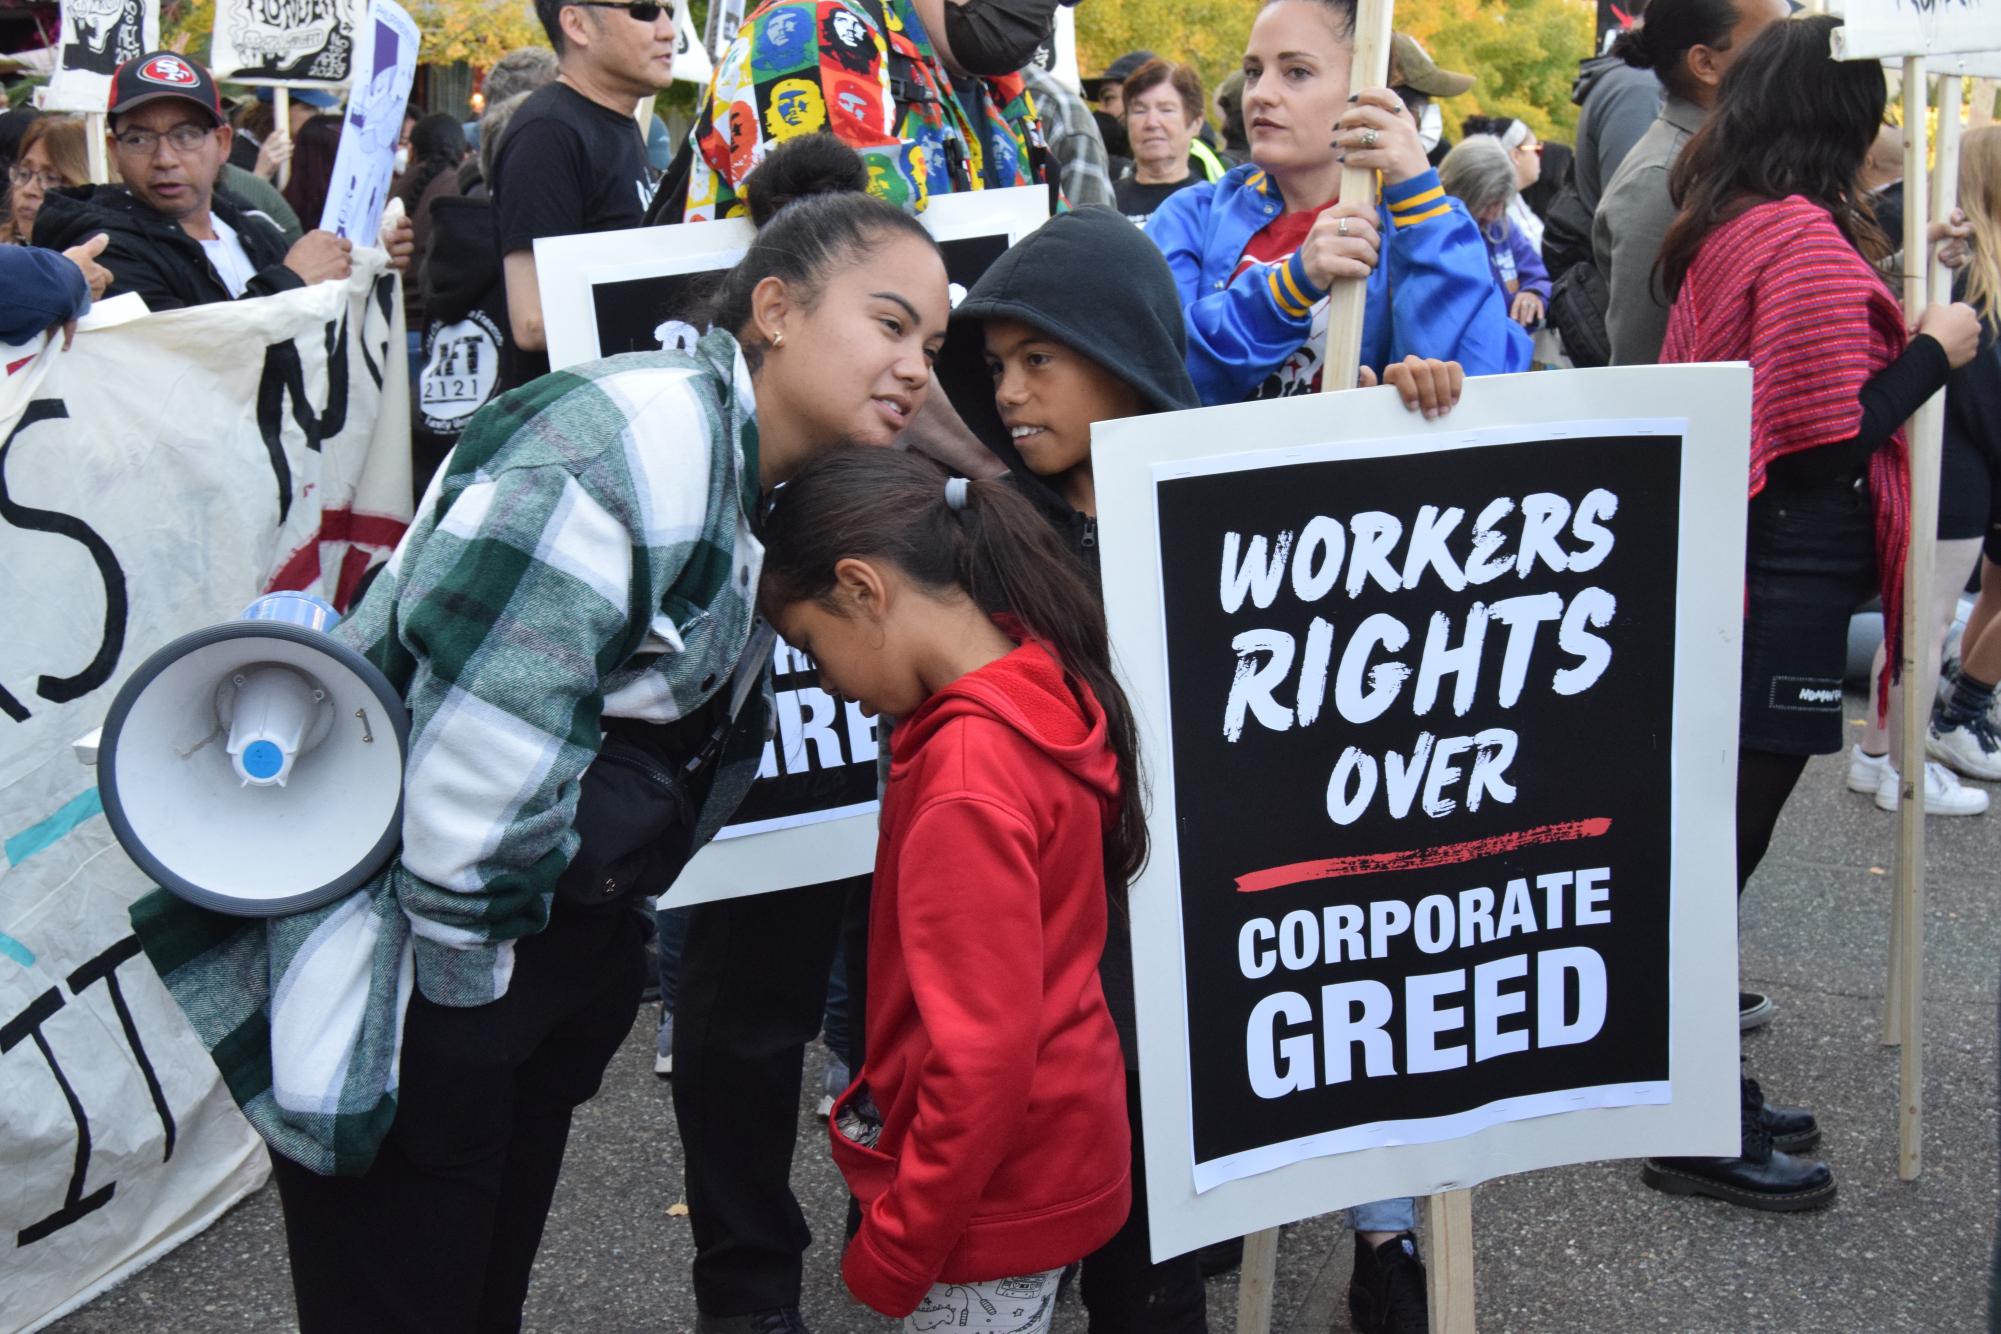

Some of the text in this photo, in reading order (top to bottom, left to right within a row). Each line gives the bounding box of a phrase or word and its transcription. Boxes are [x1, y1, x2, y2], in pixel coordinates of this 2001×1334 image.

[423, 378, 478, 399] 2121
[1219, 487, 1619, 614] WORKERS
[1222, 586, 1617, 744] RIGHTS
[1325, 727, 1518, 827] OVER
[1237, 865, 1612, 980] CORPORATE
[1245, 945, 1609, 1100] GREED
